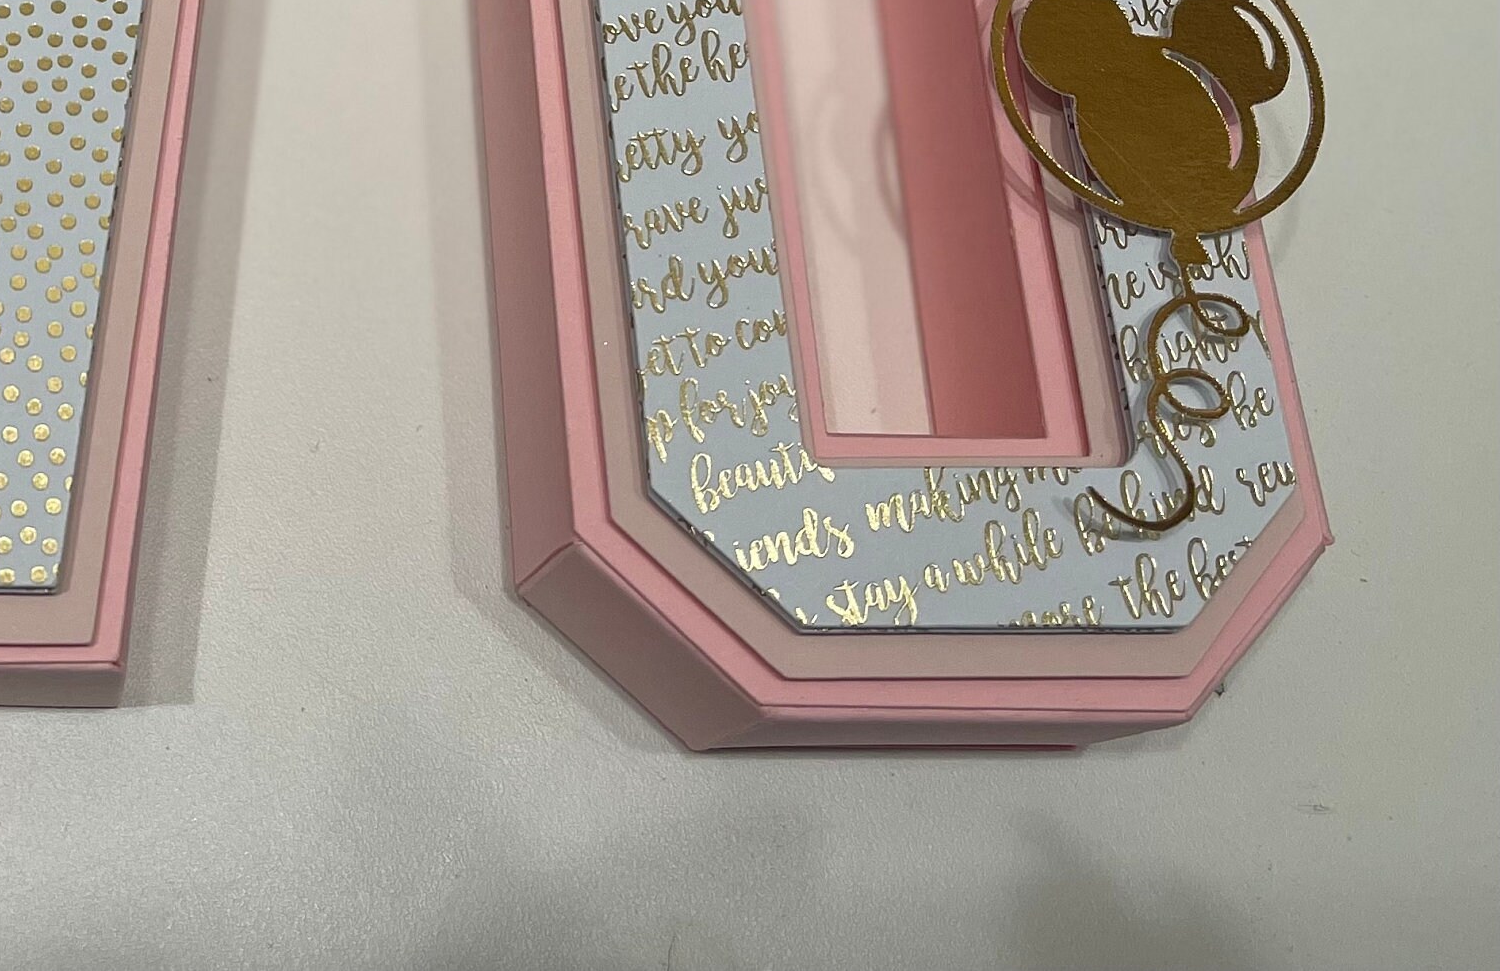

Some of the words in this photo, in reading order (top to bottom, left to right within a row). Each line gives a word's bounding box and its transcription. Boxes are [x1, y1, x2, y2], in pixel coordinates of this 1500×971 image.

[626, 41, 700, 99] the
[638, 334, 686, 387] et
[676, 326, 733, 368] to
[678, 377, 748, 444] for
[1226, 370, 1275, 431] be
[825, 574, 922, 627] stay
[952, 509, 1064, 585] while
[1108, 552, 1186, 620] the
